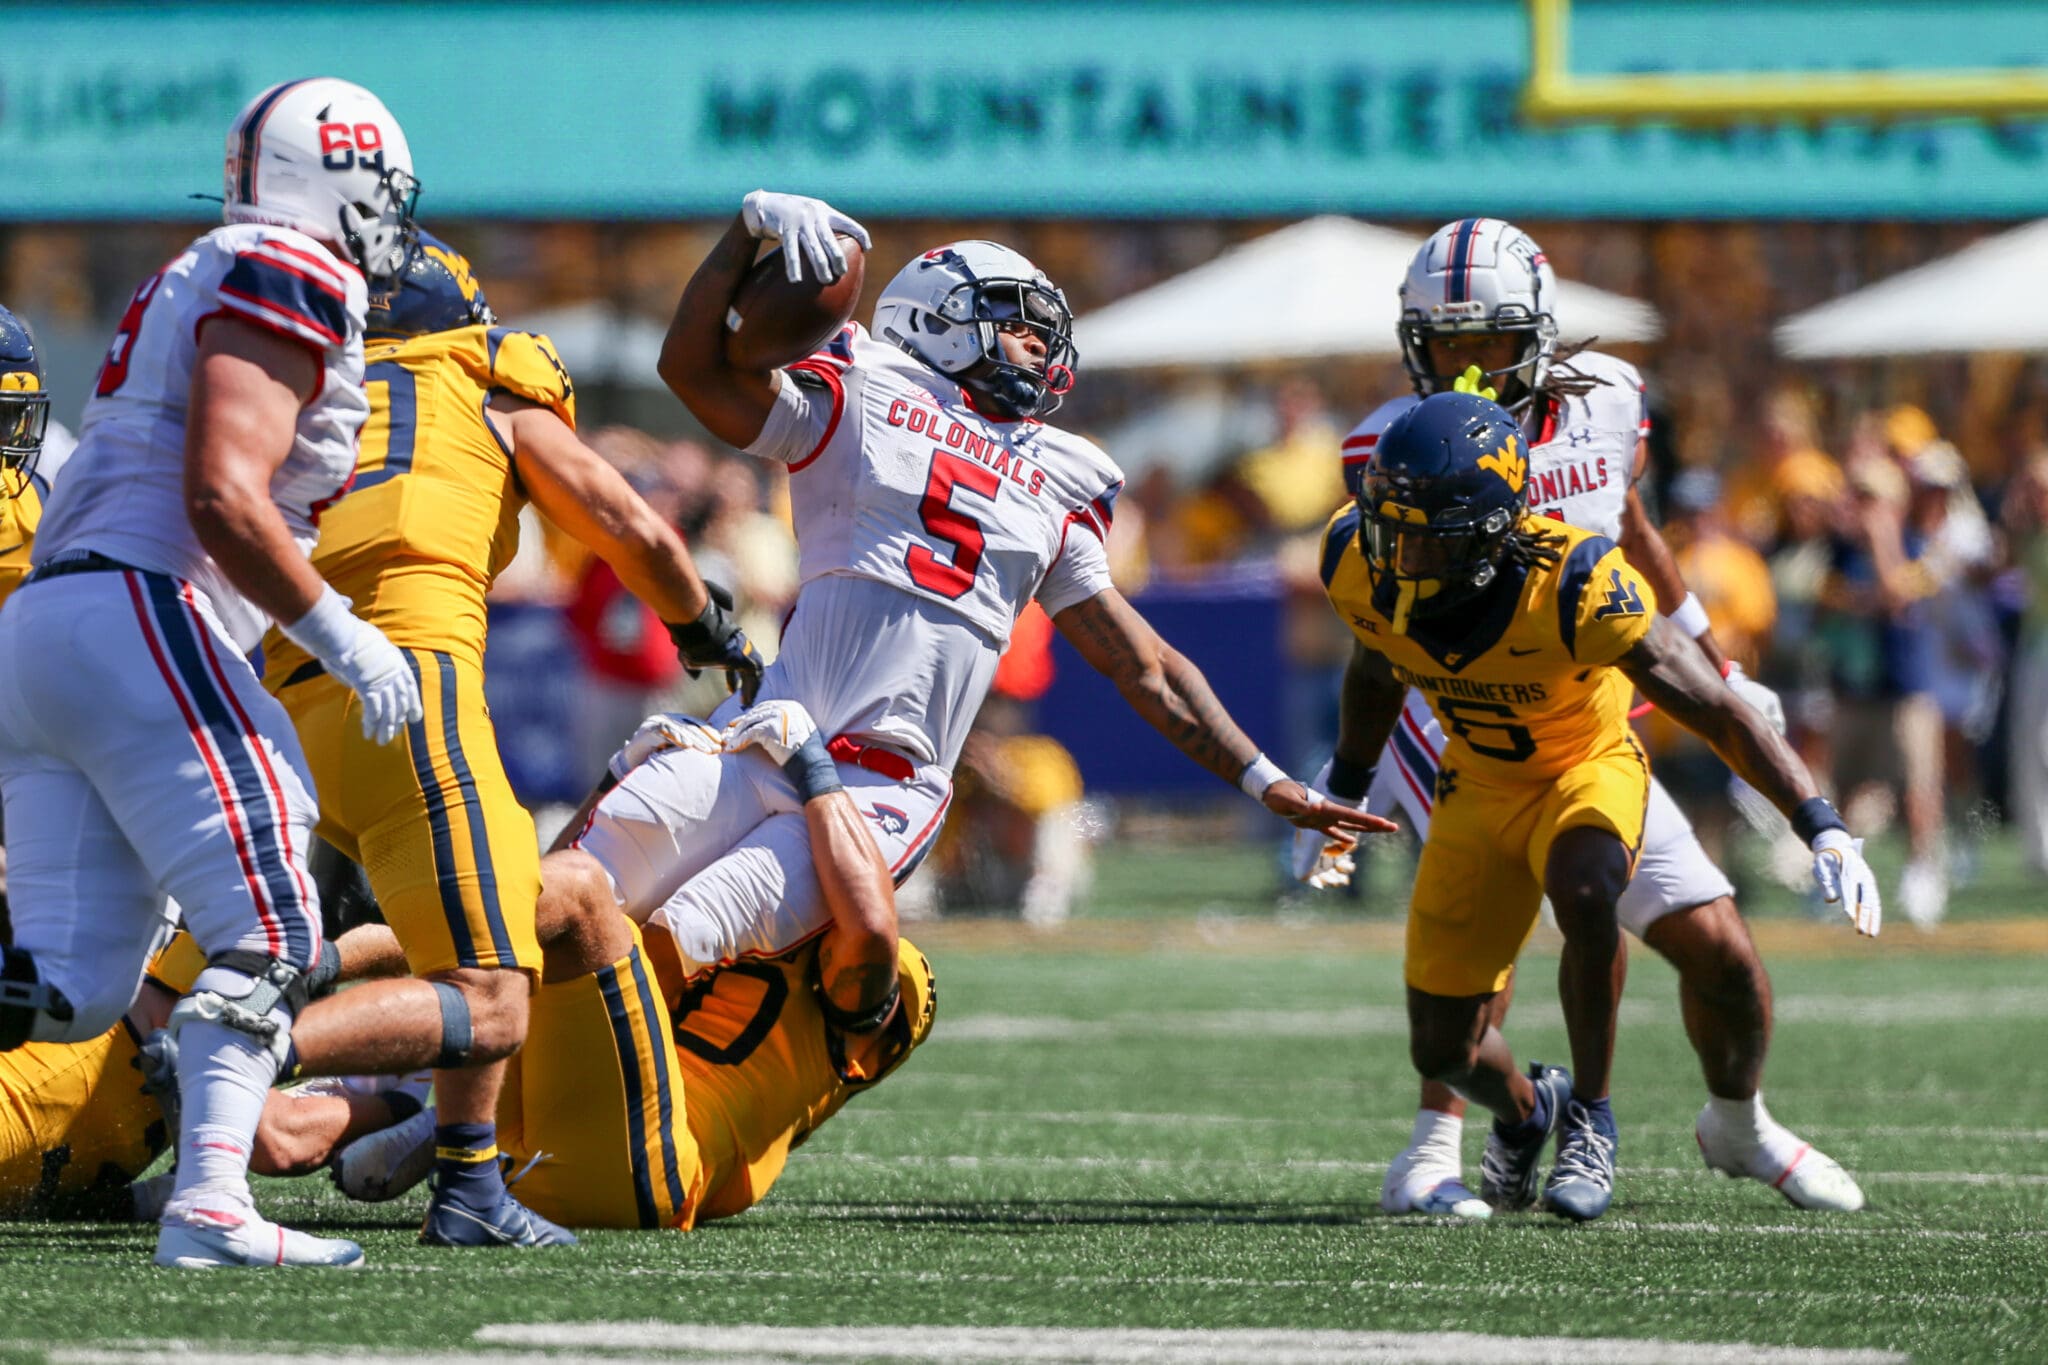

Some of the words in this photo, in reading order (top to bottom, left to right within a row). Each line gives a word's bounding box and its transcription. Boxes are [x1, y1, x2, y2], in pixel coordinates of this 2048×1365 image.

[319, 122, 386, 175] 69
[887, 398, 1046, 497] COLONIALS
[1526, 456, 1609, 507] ONIALS
[903, 447, 1002, 602] 5
[1398, 665, 1548, 705] OUNTAINEERS
